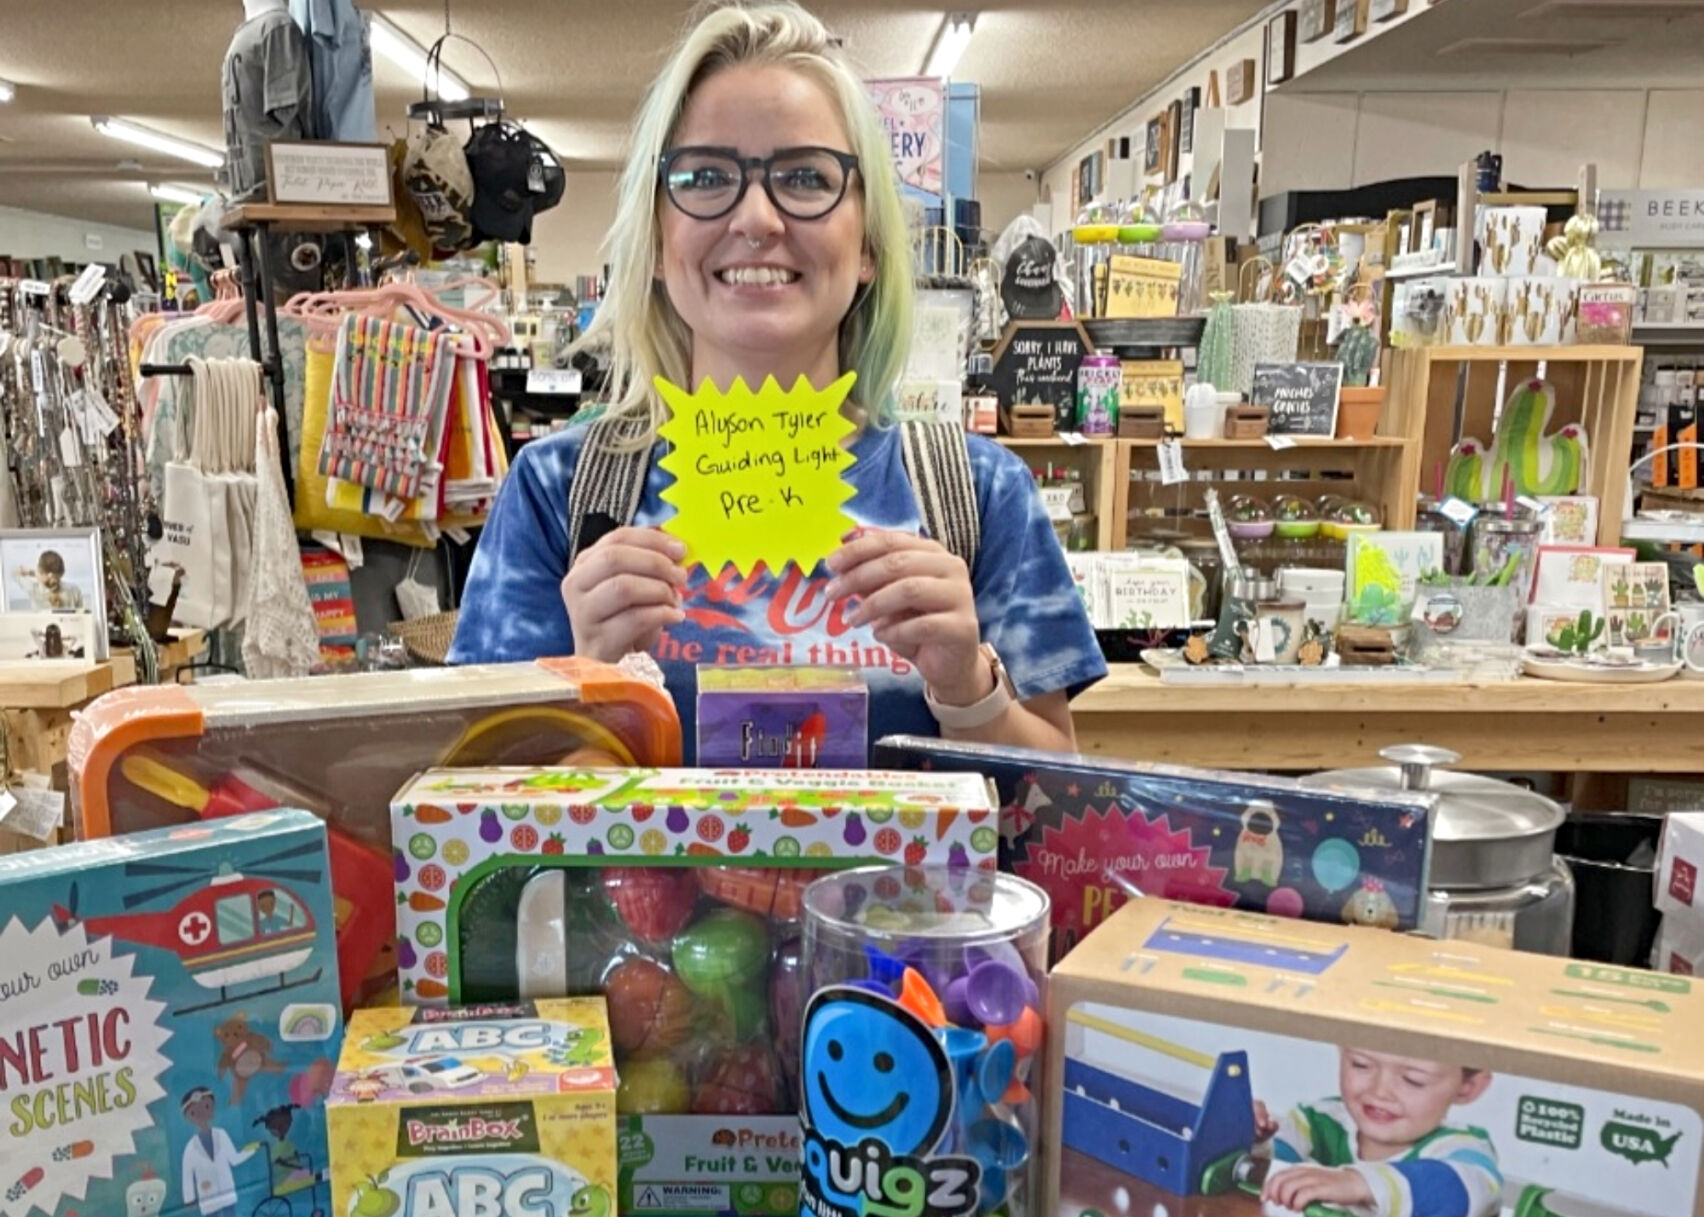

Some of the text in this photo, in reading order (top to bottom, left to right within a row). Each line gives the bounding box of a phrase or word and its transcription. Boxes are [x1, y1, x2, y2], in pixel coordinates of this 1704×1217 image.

[1027, 356, 1062, 371] PLANTS
[695, 409, 828, 448] Alyson Tyler
[696, 446, 841, 477] Guiding Light
[1115, 587, 1177, 596] BIRTHDAY
[714, 642, 793, 664] real
[807, 640, 911, 675] thing
[1038, 847, 1198, 883] Make your own
[48, 949, 99, 981] own
[0, 1006, 132, 1091] NETIC
[415, 1025, 551, 1051] ABC
[9, 1066, 137, 1137] SCENES
[1613, 1108, 1651, 1124] Made
[407, 1118, 524, 1146] BrainBox
[619, 1133, 645, 1151] 22
[1519, 1124, 1577, 1145] Plastic
[1612, 1132, 1656, 1153] USA
[684, 1155, 737, 1173] Fruit
[743, 1155, 758, 1173] &
[408, 1167, 553, 1217] ABC
